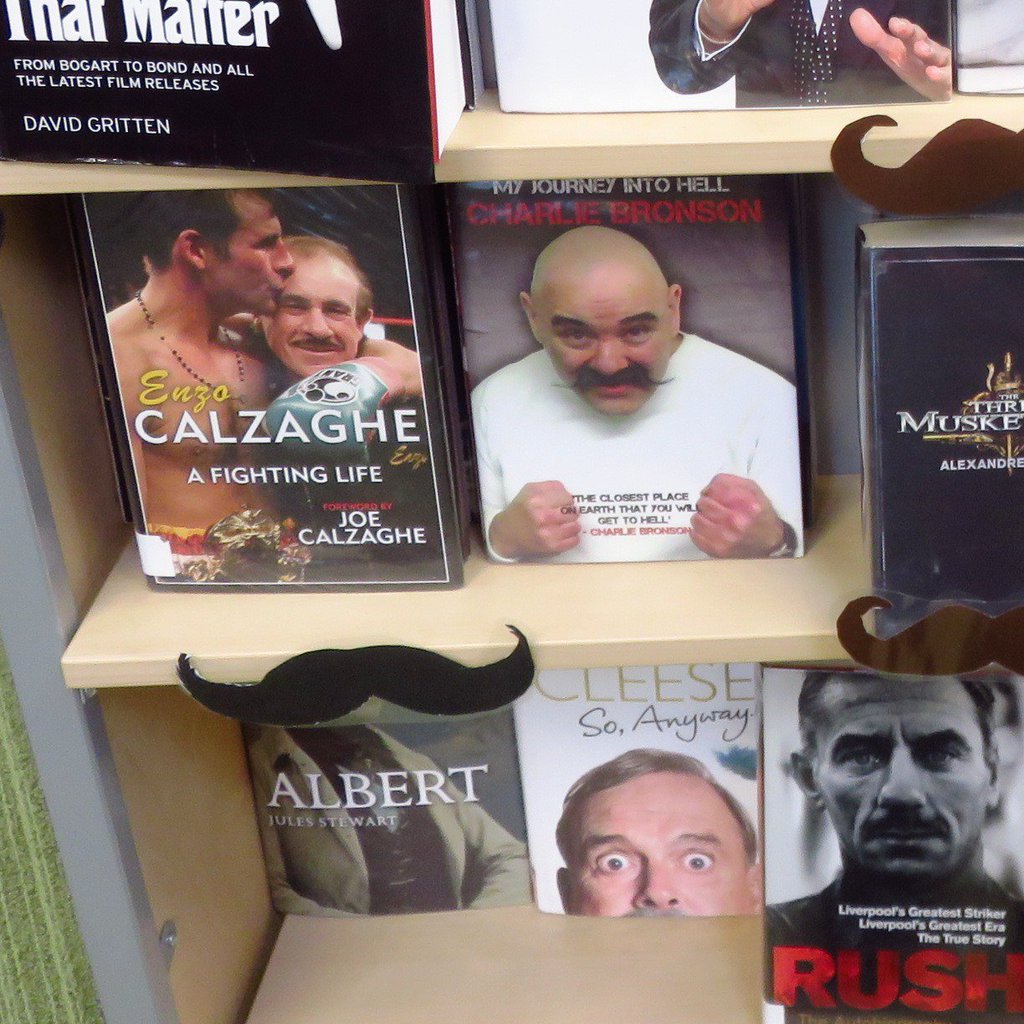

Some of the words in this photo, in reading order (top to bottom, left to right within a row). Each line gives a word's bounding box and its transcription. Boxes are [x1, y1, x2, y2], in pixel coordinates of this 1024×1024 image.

[14, 59, 56, 71] FROM
[60, 60, 120, 73] BOGART
[125, 61, 143, 73] TO
[147, 61, 187, 75] BOND
[192, 62, 223, 76] AND
[227, 63, 254, 76] ALL
[16, 75, 47, 88] THE
[50, 75, 103, 88] LATEST
[107, 76, 142, 89] FILM
[145, 78, 220, 91] RELEASES
[24, 116, 82, 132] DAVID
[87, 117, 171, 134] GRITTEN
[493, 180, 522, 195] MY
[532, 178, 618, 194] JOURNEY
[623, 178, 671, 194] INTO
[677, 177, 730, 193] HELL
[466, 201, 600, 225] CHARLIE
[610, 199, 763, 224] BRONSON
[139, 370, 231, 412] Enzo
[998, 393, 1019, 401] THE
[135, 409, 420, 445] CALZAGHE
[187, 468, 205, 484] A
[211, 466, 328, 484] FIGHTING
[335, 466, 383, 483] LIFE
[600, 493, 649, 502] CLOSEST
[653, 493, 689, 501] PLACE
[323, 502, 377, 511] FOREWORD
[380, 502, 393, 511] BY
[560, 507, 576, 515] ON
[579, 506, 616, 514] EARTH
[619, 505, 647, 513] THAT
[675, 504, 701, 512] WILL
[339, 511, 381, 527] JOE
[598, 516, 618, 525] GET
[623, 516, 637, 524] TO
[299, 528, 427, 546] CALZAGHE
[590, 528, 636, 536] CHARLIE
[640, 527, 692, 535] BRONSON
[533, 663, 755, 703] CLEESE
[578, 707, 624, 738] So,
[267, 764, 489, 809] ALBERT
[268, 815, 314, 827] JULES
[318, 815, 398, 827] STEWART
[838, 905, 906, 917] Liverpool's
[908, 907, 962, 918] Greatest
[964, 908, 1006, 920] Striker
[859, 918, 926, 932] Liverpool's
[928, 920, 983, 931] Greatest
[985, 922, 1006, 932] Era
[917, 933, 940, 944] The
[943, 933, 969, 945] True
[972, 934, 1006, 947] Story
